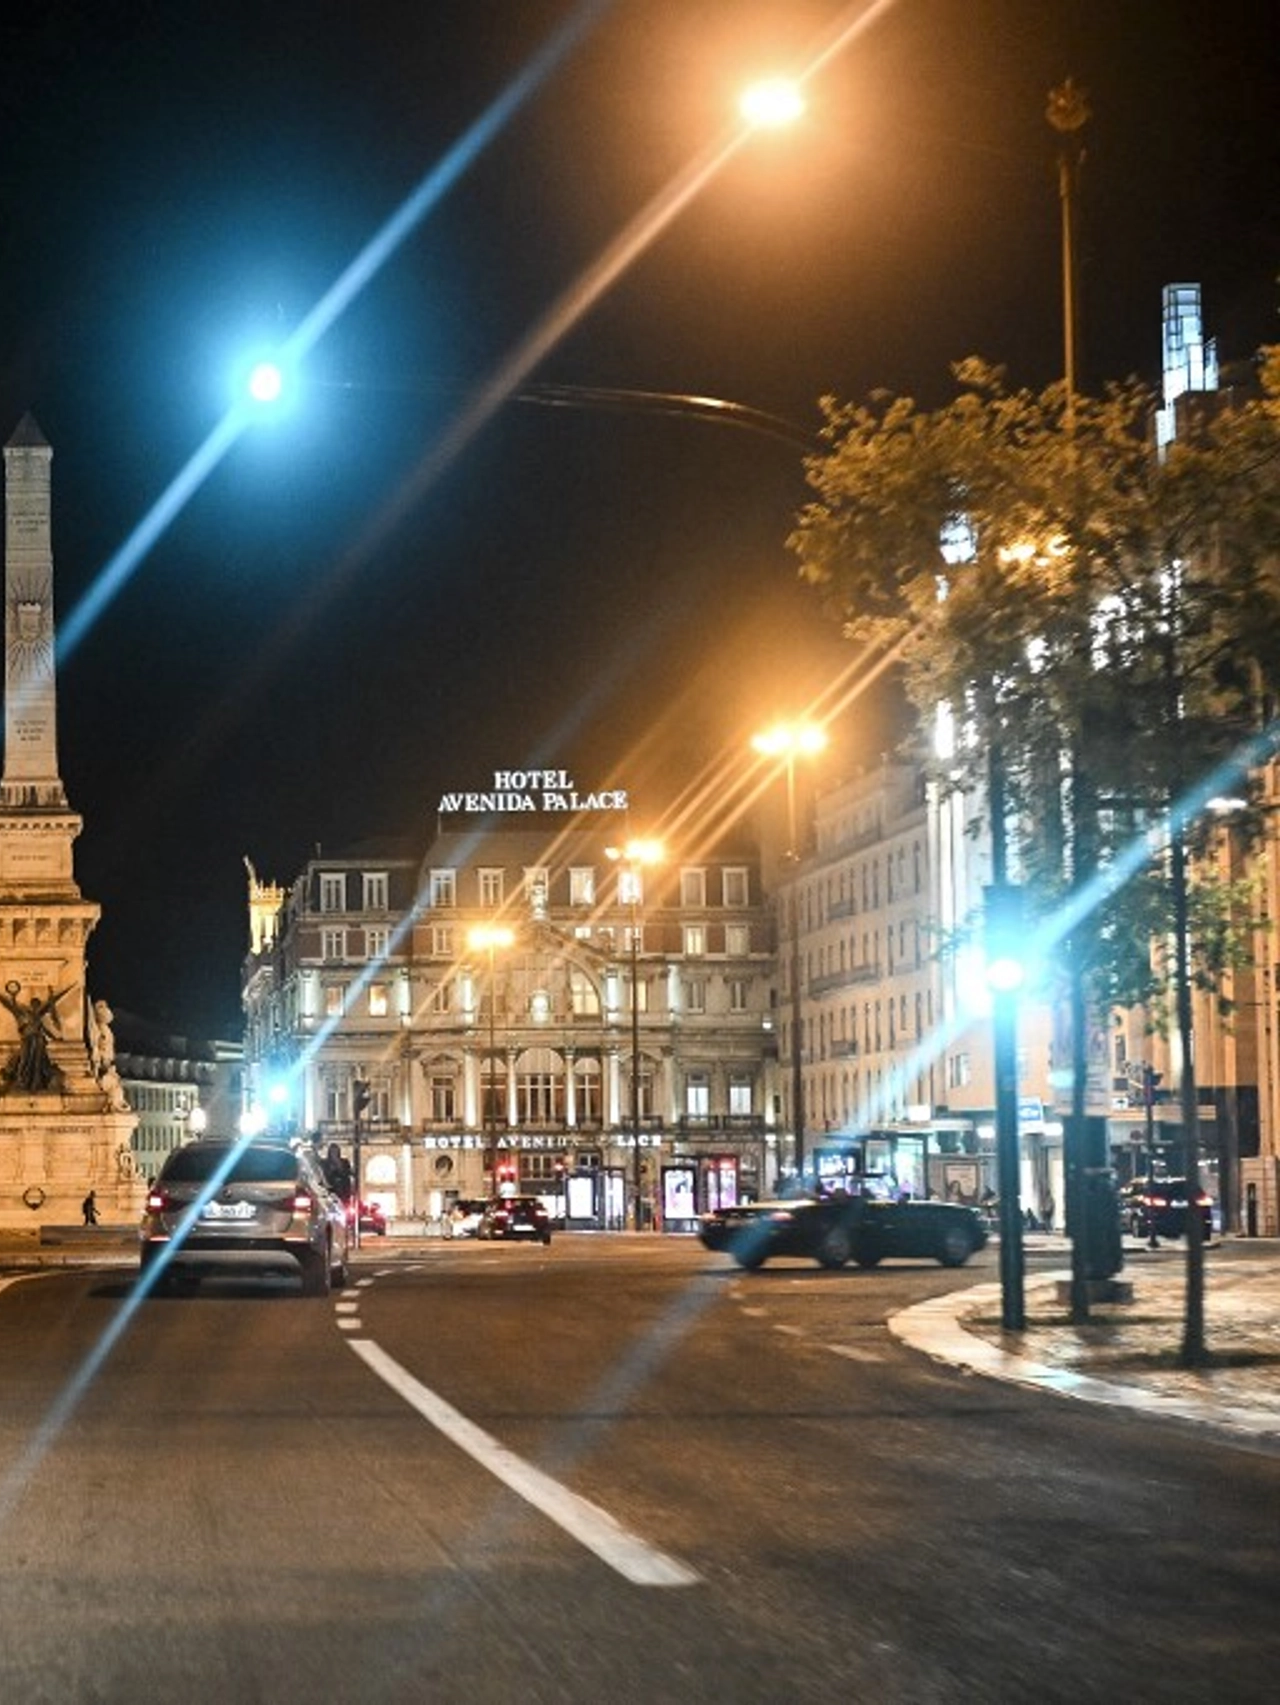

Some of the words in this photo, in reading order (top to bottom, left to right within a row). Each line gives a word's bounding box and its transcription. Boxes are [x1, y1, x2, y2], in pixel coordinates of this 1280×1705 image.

[494, 771, 573, 790] HOTEL
[437, 793, 535, 812] AVENIDA
[542, 791, 629, 811] PALACE
[423, 1136, 485, 1149] HOTEL
